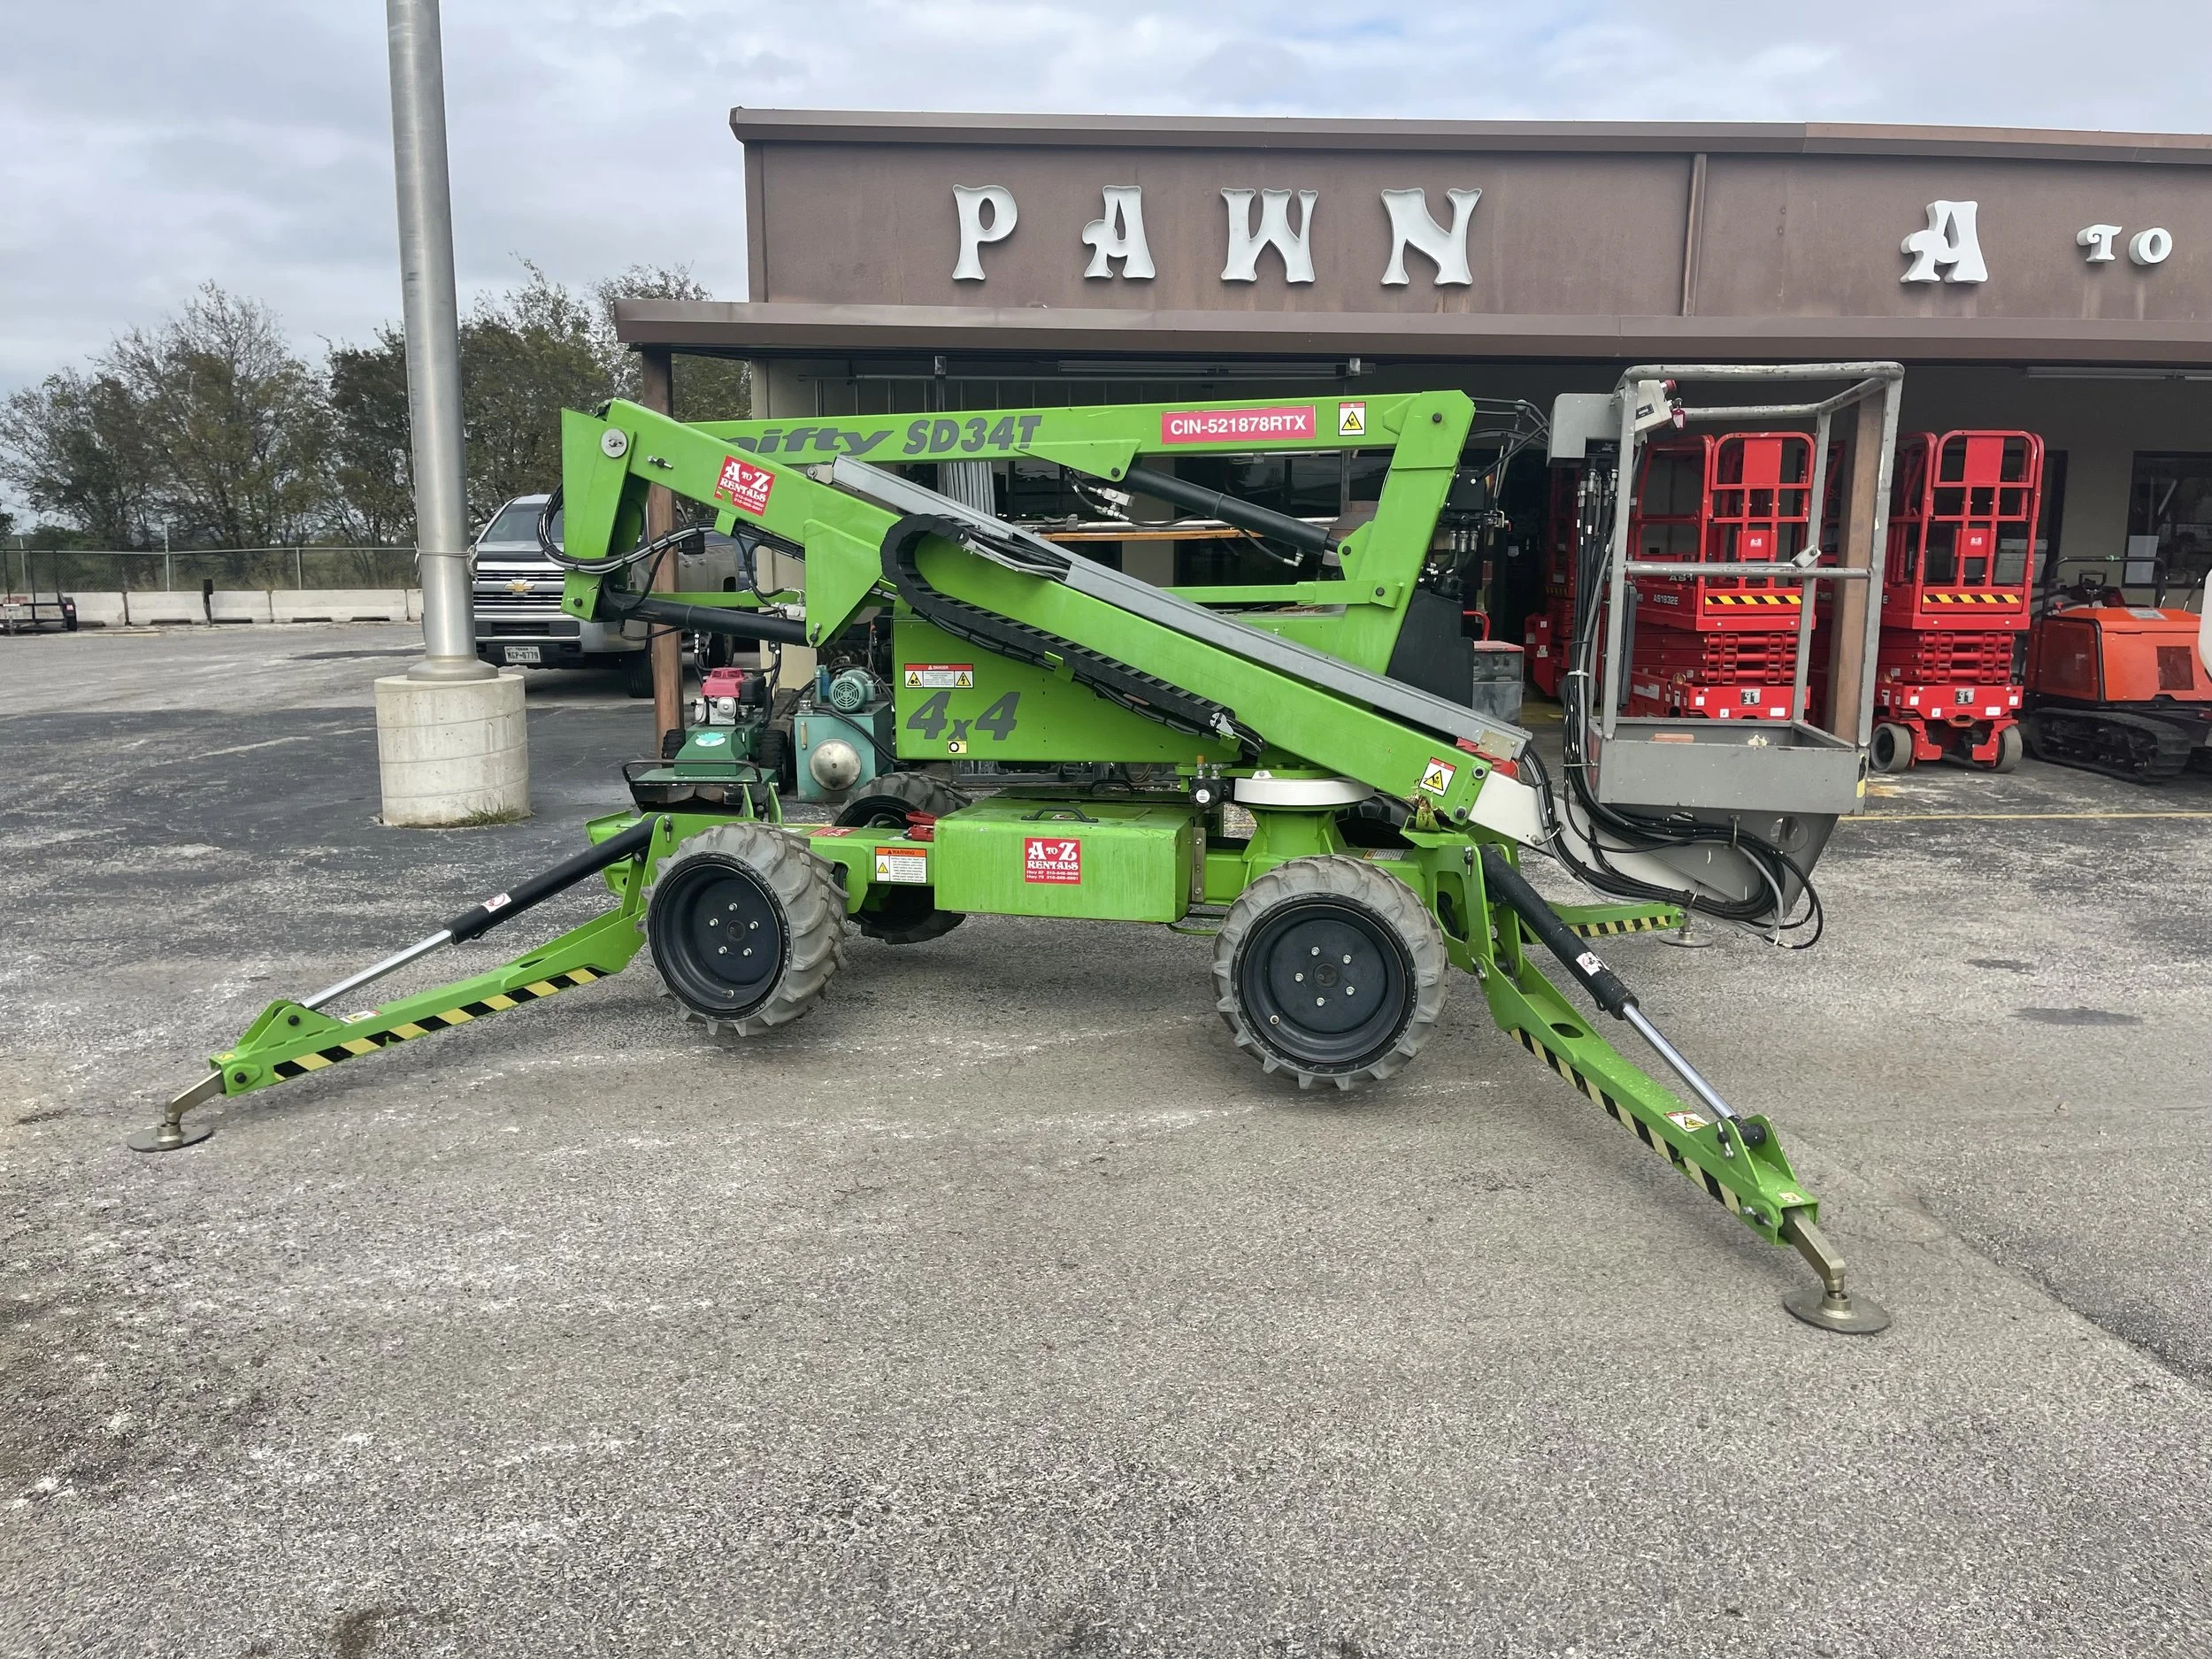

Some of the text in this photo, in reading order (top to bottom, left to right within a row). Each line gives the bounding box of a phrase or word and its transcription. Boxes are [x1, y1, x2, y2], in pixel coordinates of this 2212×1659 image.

[952, 184, 1482, 285] PAWN
[1900, 200, 2173, 284] A TO
[902, 415, 1042, 454] SD34T
[1170, 415, 1306, 435] CIN-521878RTX
[719, 477, 767, 503] RENTALS
[723, 461, 741, 483] A
[741, 471, 753, 481] TO
[750, 472, 771, 493] Z
[1027, 860, 1079, 871] RENTALS
[1028, 841, 1047, 860] A
[1058, 841, 1078, 861] Z
